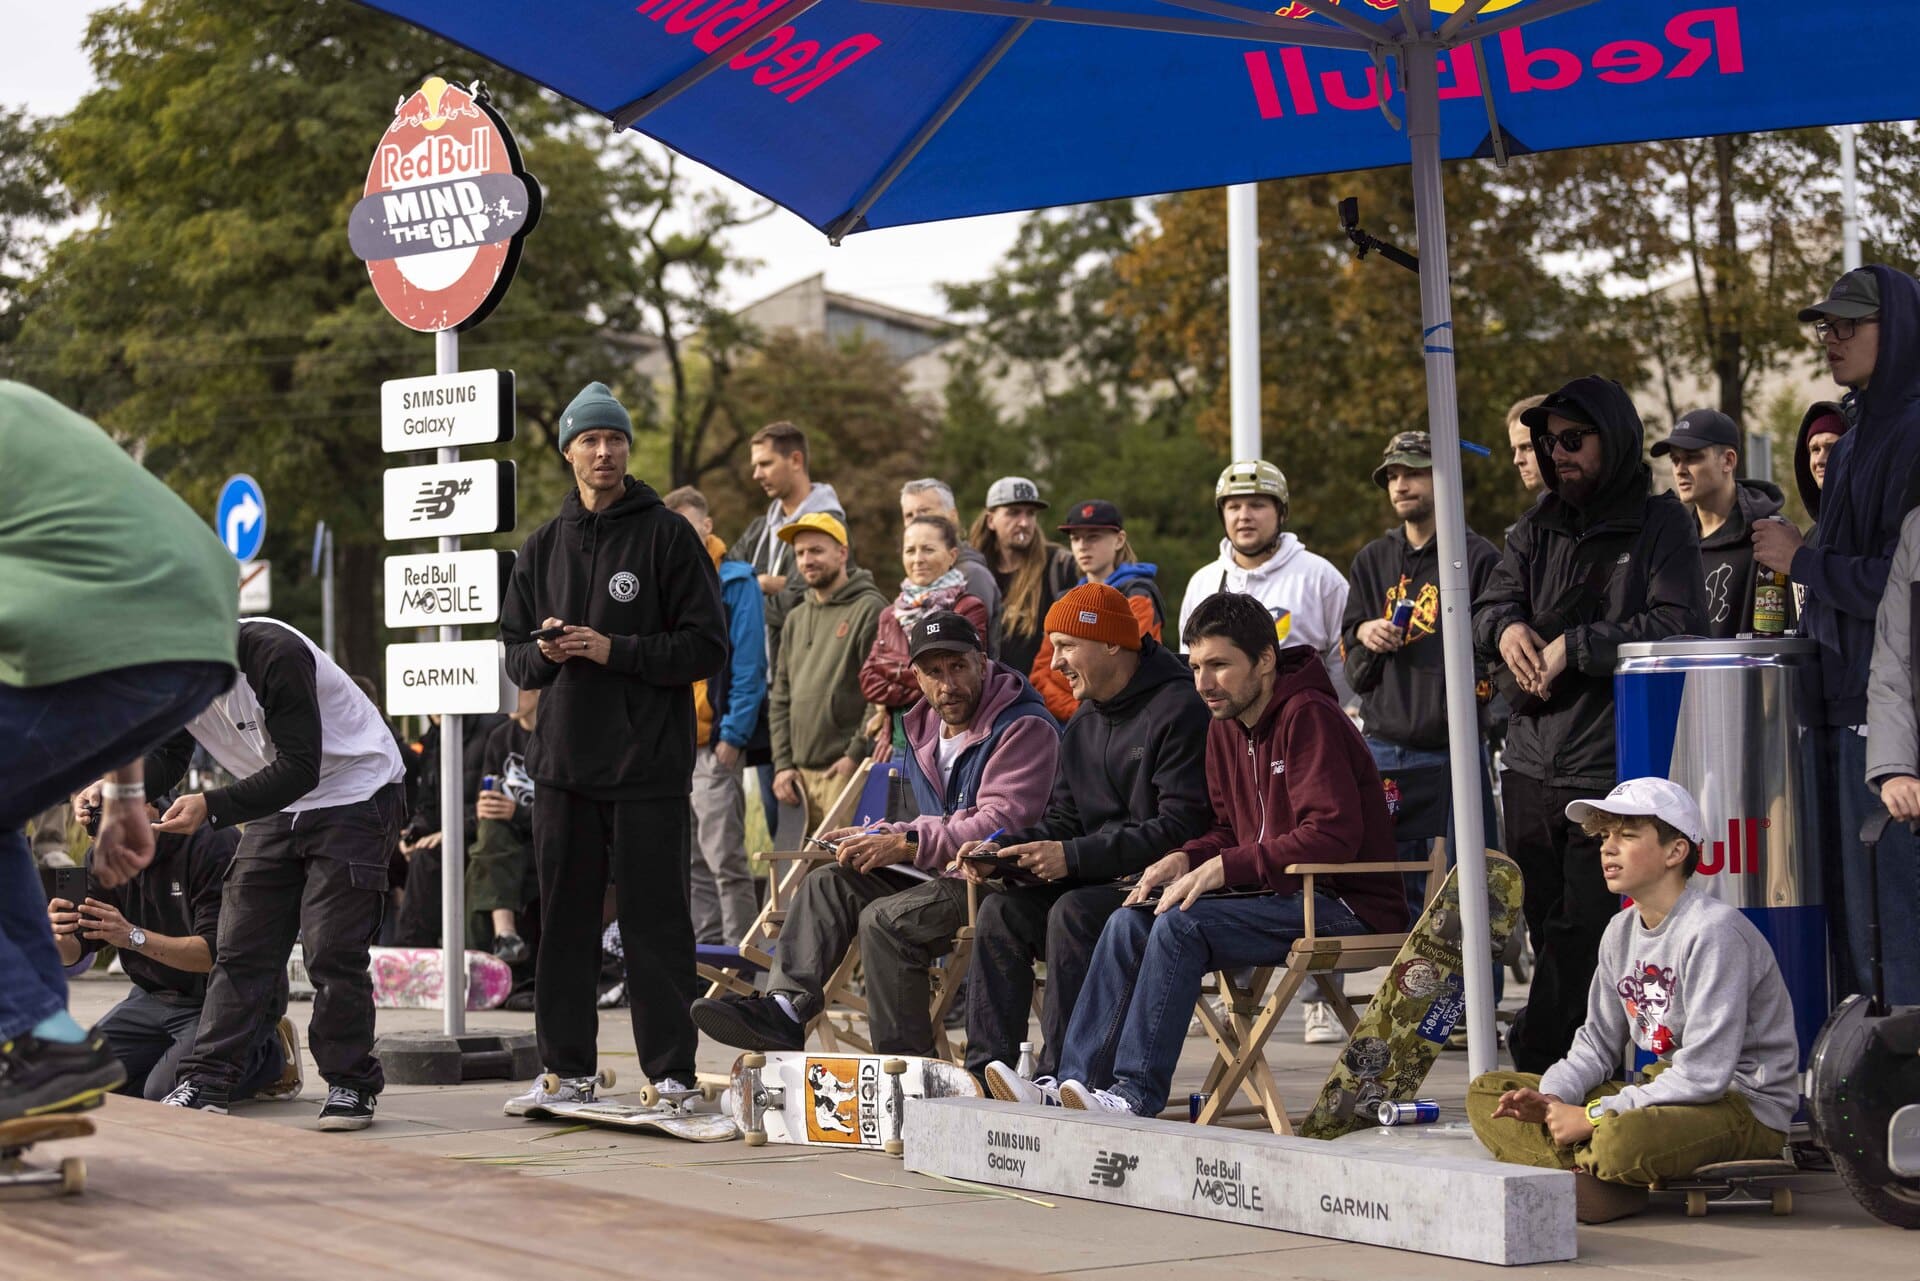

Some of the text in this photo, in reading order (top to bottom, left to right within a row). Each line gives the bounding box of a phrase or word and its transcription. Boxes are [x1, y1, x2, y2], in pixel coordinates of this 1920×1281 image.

[383, 129, 488, 184] Red Bull
[383, 181, 484, 225] MIND
[389, 213, 490, 249] THE GAP
[403, 385, 476, 410] SAMSUNG
[403, 416, 455, 437] Galaxy
[405, 563, 456, 586] Red Bull
[400, 585, 482, 615] MOBILE
[403, 667, 475, 687] GARMIN
[1695, 817, 1759, 876] ull
[987, 1130, 1041, 1152] SAMSUNG
[987, 1152, 1026, 1178] Galaxy
[1196, 1157, 1241, 1181] Red Bull
[1192, 1177, 1264, 1212] MOBILE
[1320, 1194, 1390, 1221] GARMIN
